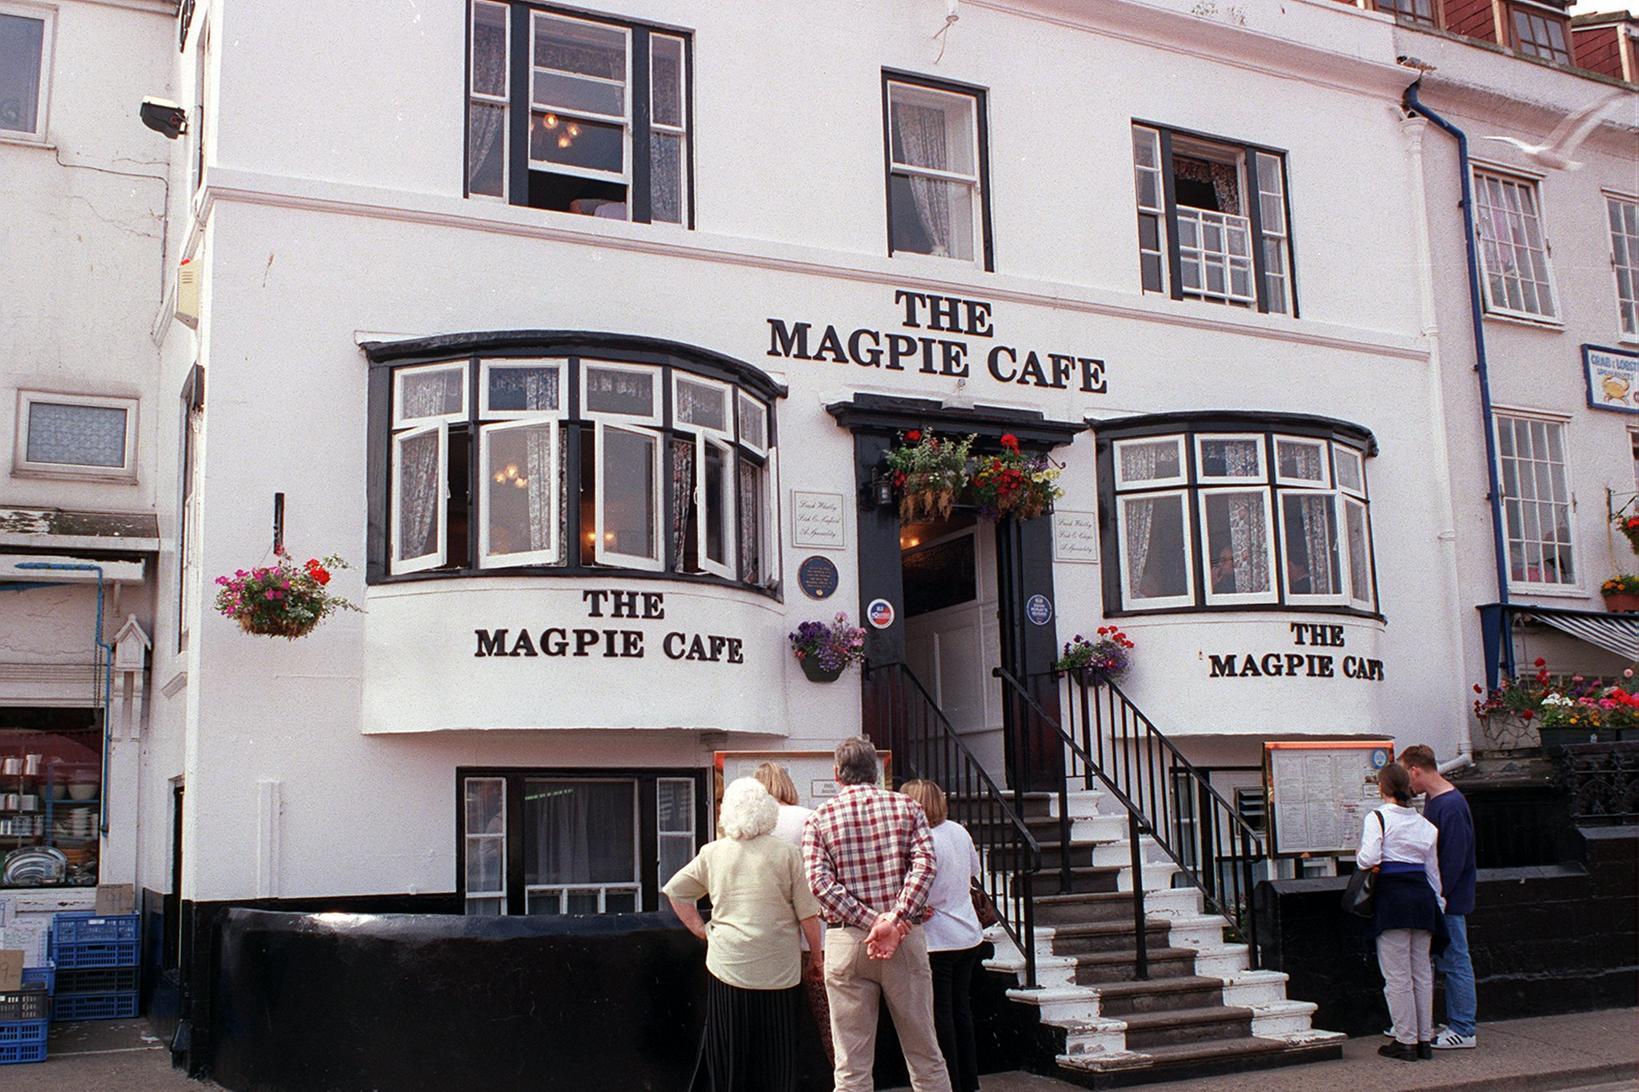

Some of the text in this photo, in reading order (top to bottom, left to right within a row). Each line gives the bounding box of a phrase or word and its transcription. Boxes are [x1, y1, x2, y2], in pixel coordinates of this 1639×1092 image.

[895, 290, 993, 337] THE
[767, 319, 1108, 395] MAGPIE CAFE
[583, 590, 664, 620] THE
[475, 629, 744, 664] MAGPIE CAFE
[1291, 623, 1344, 647] THE
[1209, 653, 1334, 678] MAGPIE
